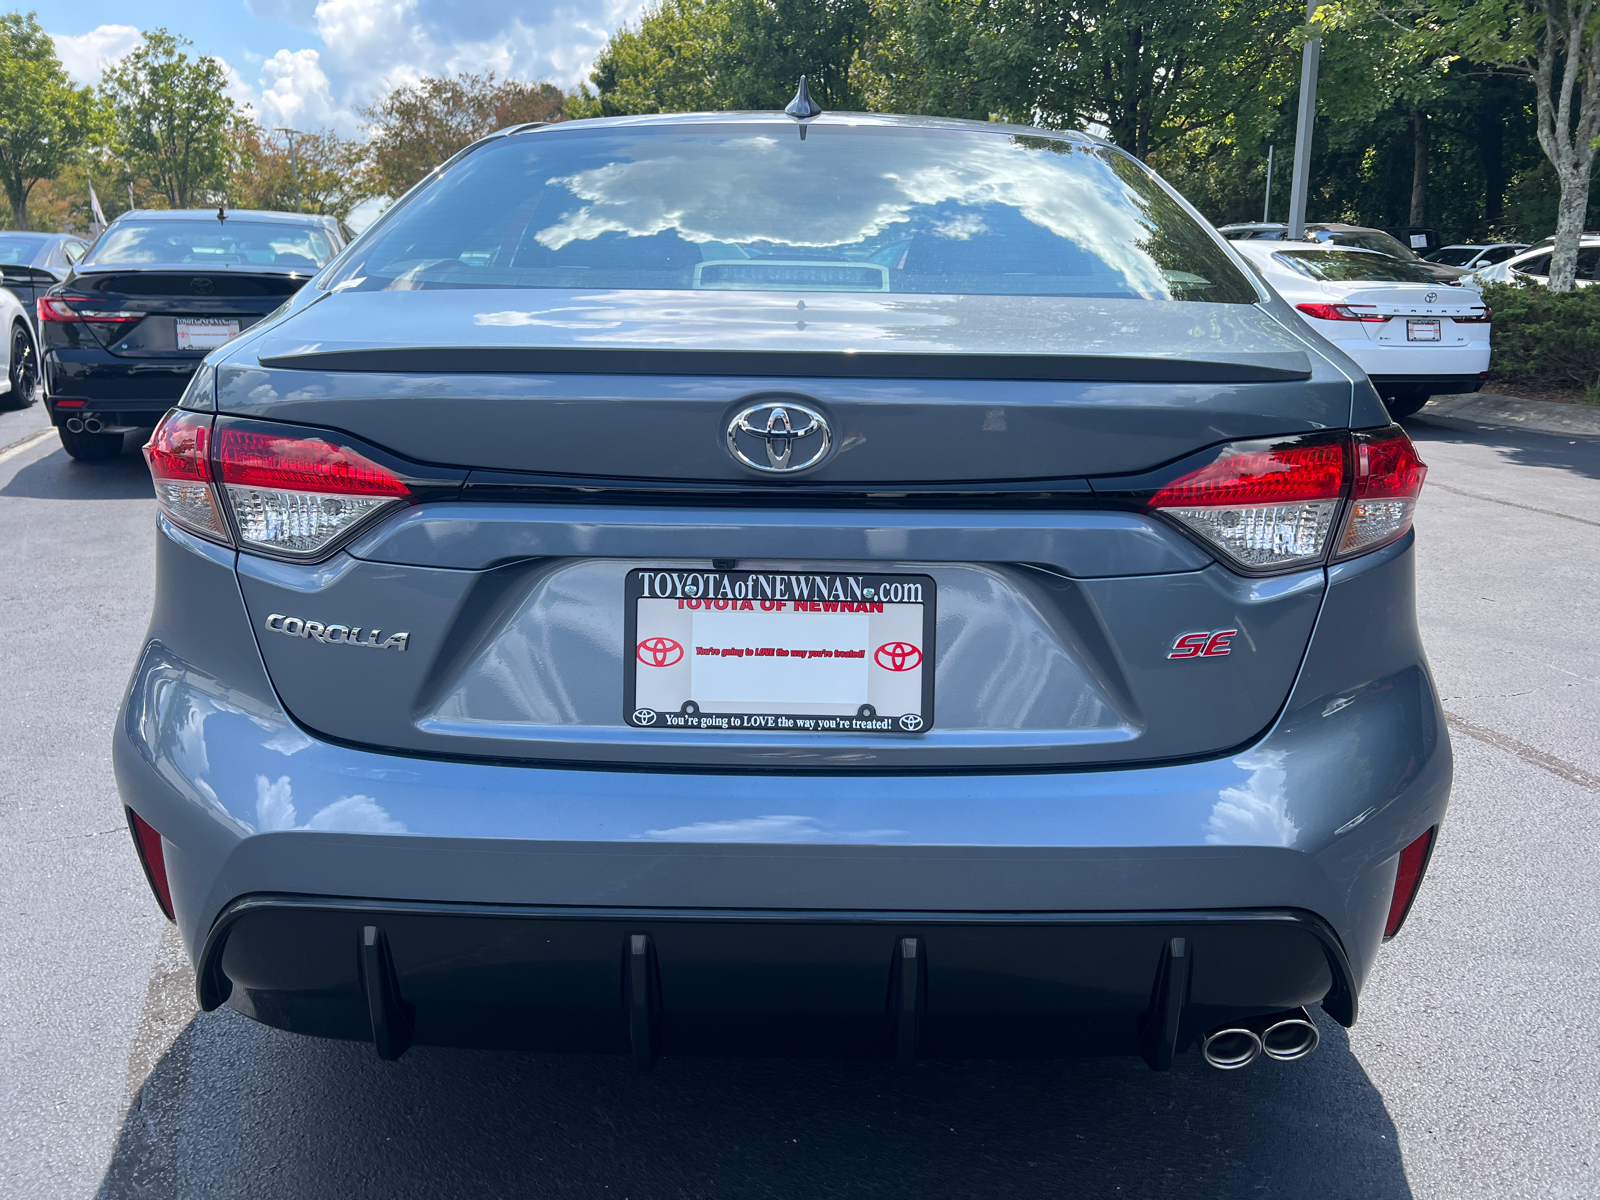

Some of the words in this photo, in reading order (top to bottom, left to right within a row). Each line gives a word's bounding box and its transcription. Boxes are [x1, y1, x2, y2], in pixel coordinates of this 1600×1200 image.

[676, 599, 755, 611] TOYOTA
[760, 600, 787, 612] OF
[794, 600, 884, 614] NEWNAN
[265, 613, 411, 651] COROLLA
[695, 646, 721, 656] You're
[721, 647, 745, 658] going
[745, 647, 755, 657] to
[755, 647, 776, 657] LOVE
[775, 648, 790, 657] the
[790, 650, 808, 659] way
[808, 649, 834, 659] you're
[834, 649, 866, 659] treated!
[1165, 628, 1239, 660] SE
[665, 714, 699, 726] You're
[700, 715, 729, 729] going
[730, 717, 741, 727] to
[743, 715, 776, 727] LOVE
[777, 716, 794, 727] the
[796, 719, 816, 730] way
[817, 717, 851, 731] you're
[852, 718, 892, 730] treated!
